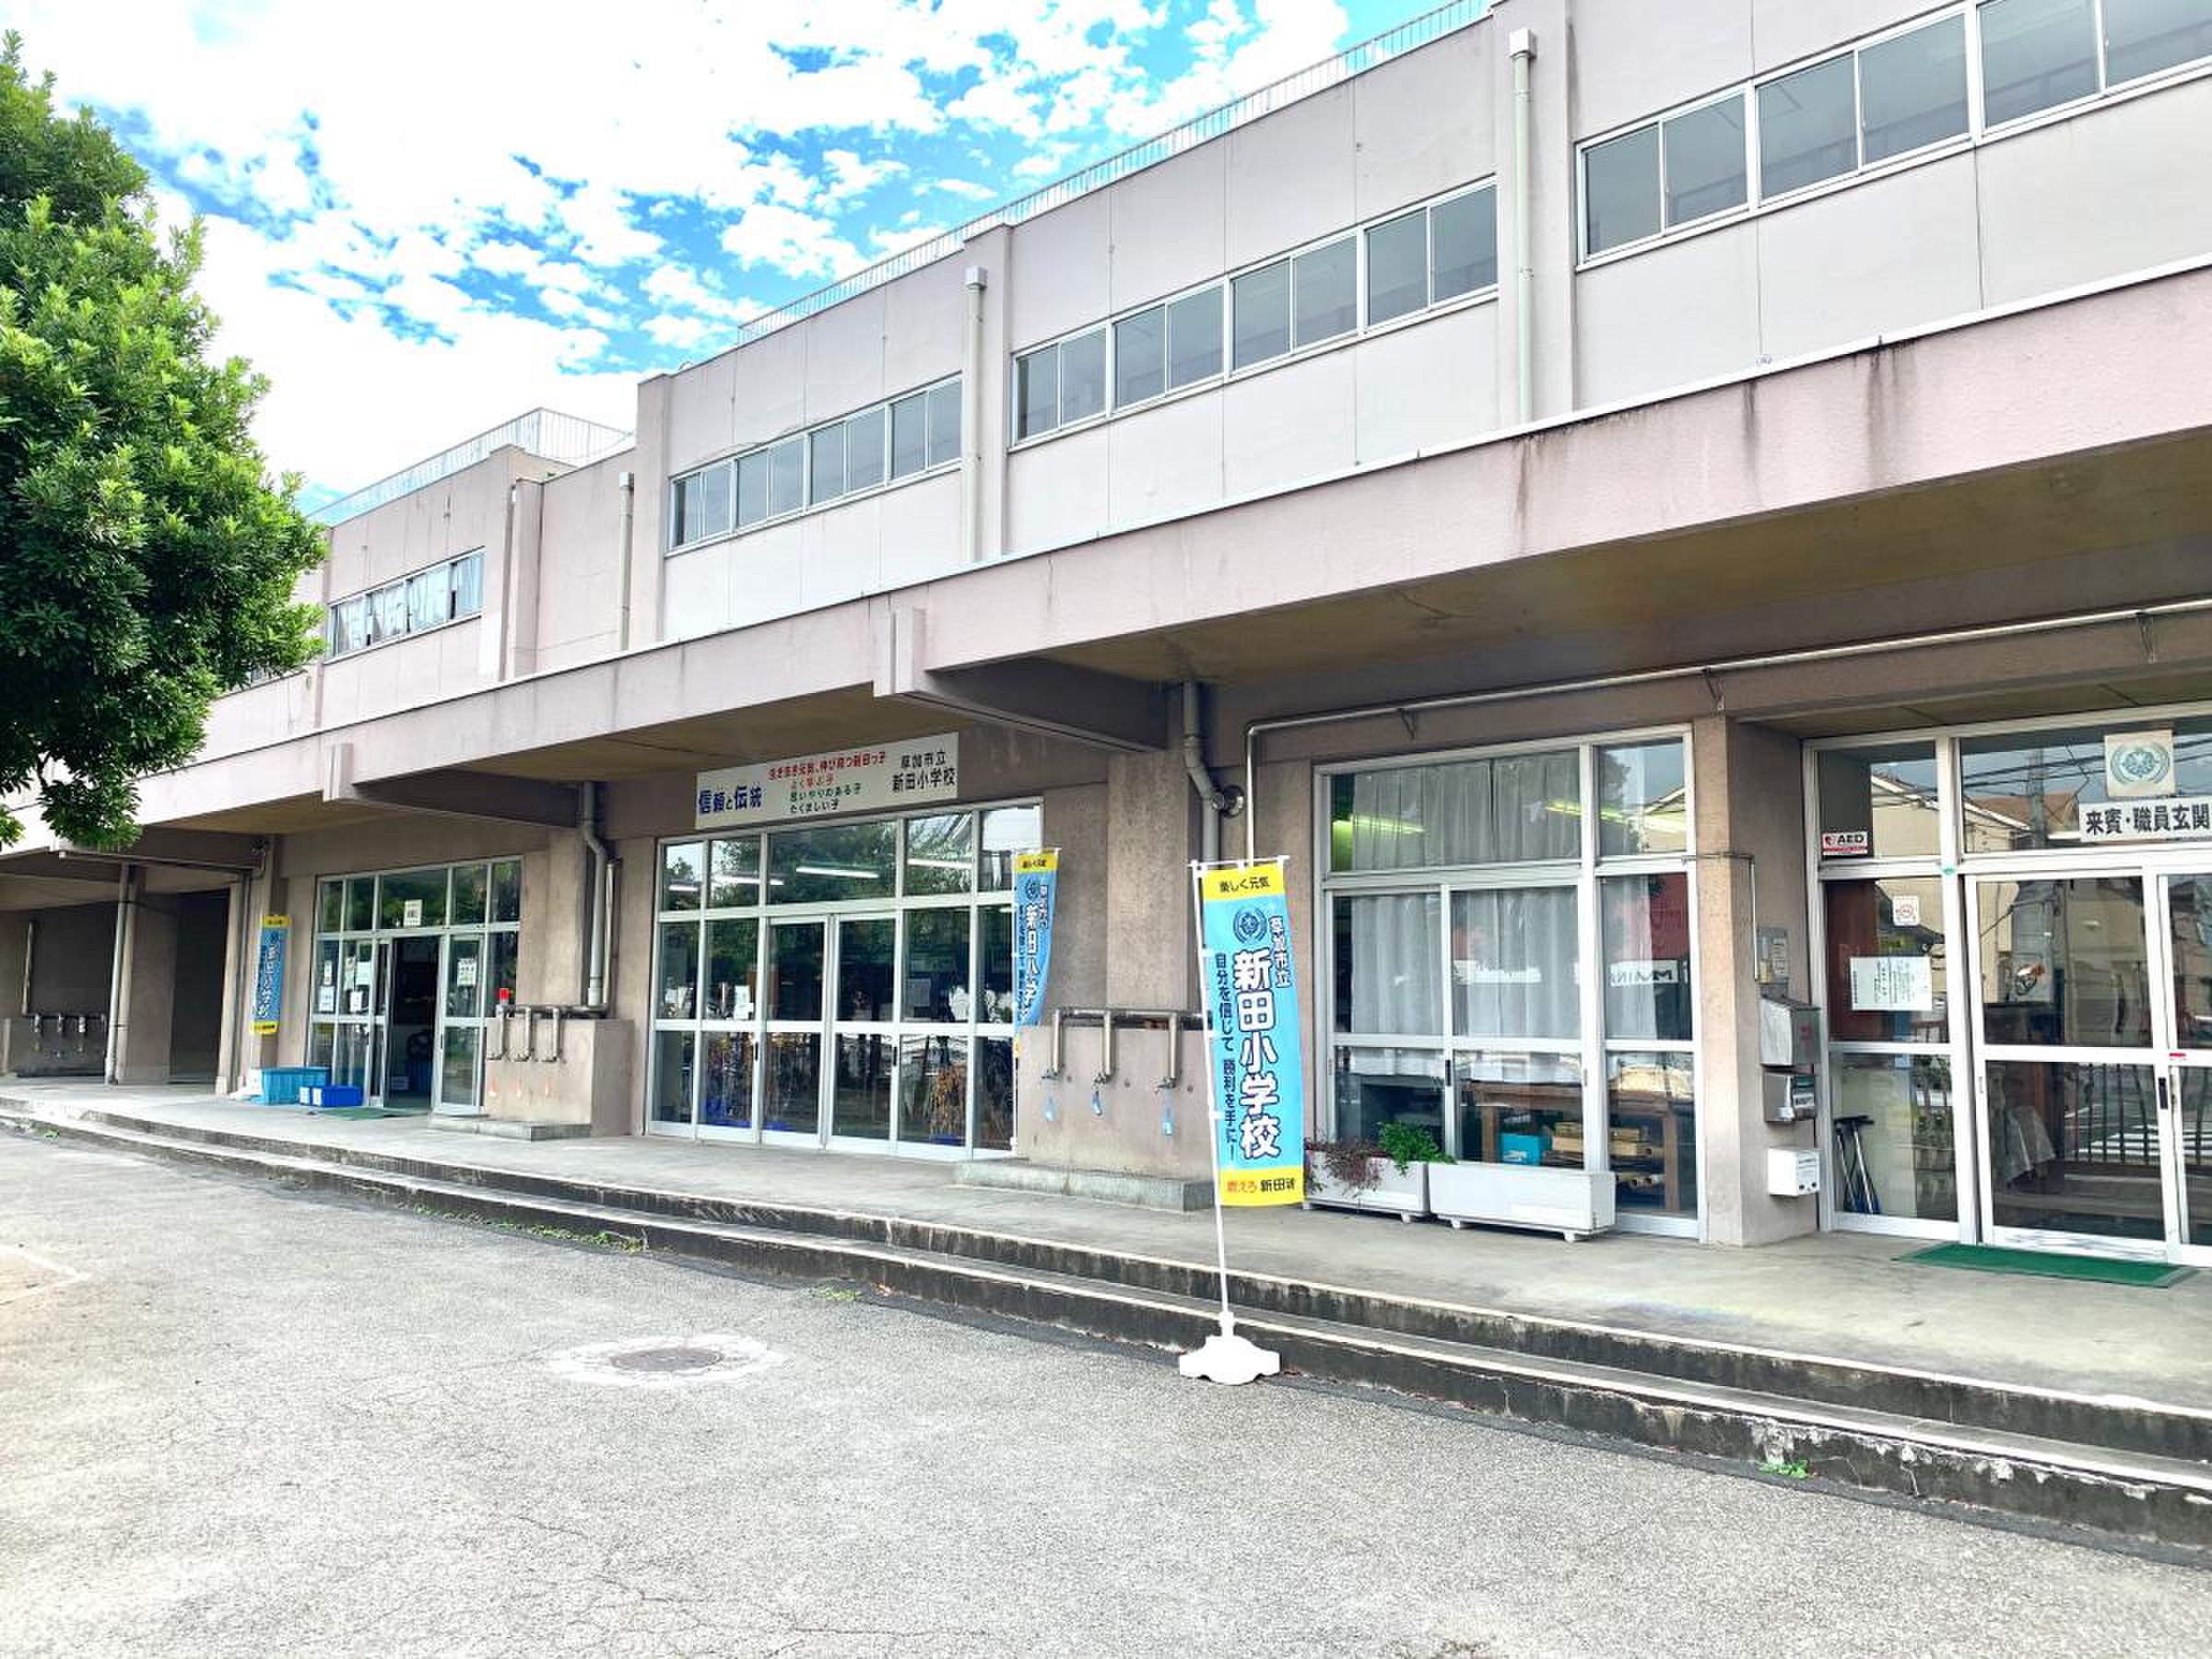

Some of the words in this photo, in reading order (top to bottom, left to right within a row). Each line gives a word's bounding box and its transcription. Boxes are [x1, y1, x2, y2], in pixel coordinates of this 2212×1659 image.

[900, 750, 946, 770] 草加市立
[892, 767, 956, 793] 新田小学校
[699, 784, 762, 815] 信頼と伝統
[790, 797, 840, 813] たくましい子
[2086, 804, 2210, 836] 来賓・職員玄関
[1838, 834, 1865, 845] AED
[1219, 875, 1271, 893] 楽しく元気
[1215, 953, 1234, 1052] 自分を信じて
[1232, 947, 1281, 1160] 新田小学校
